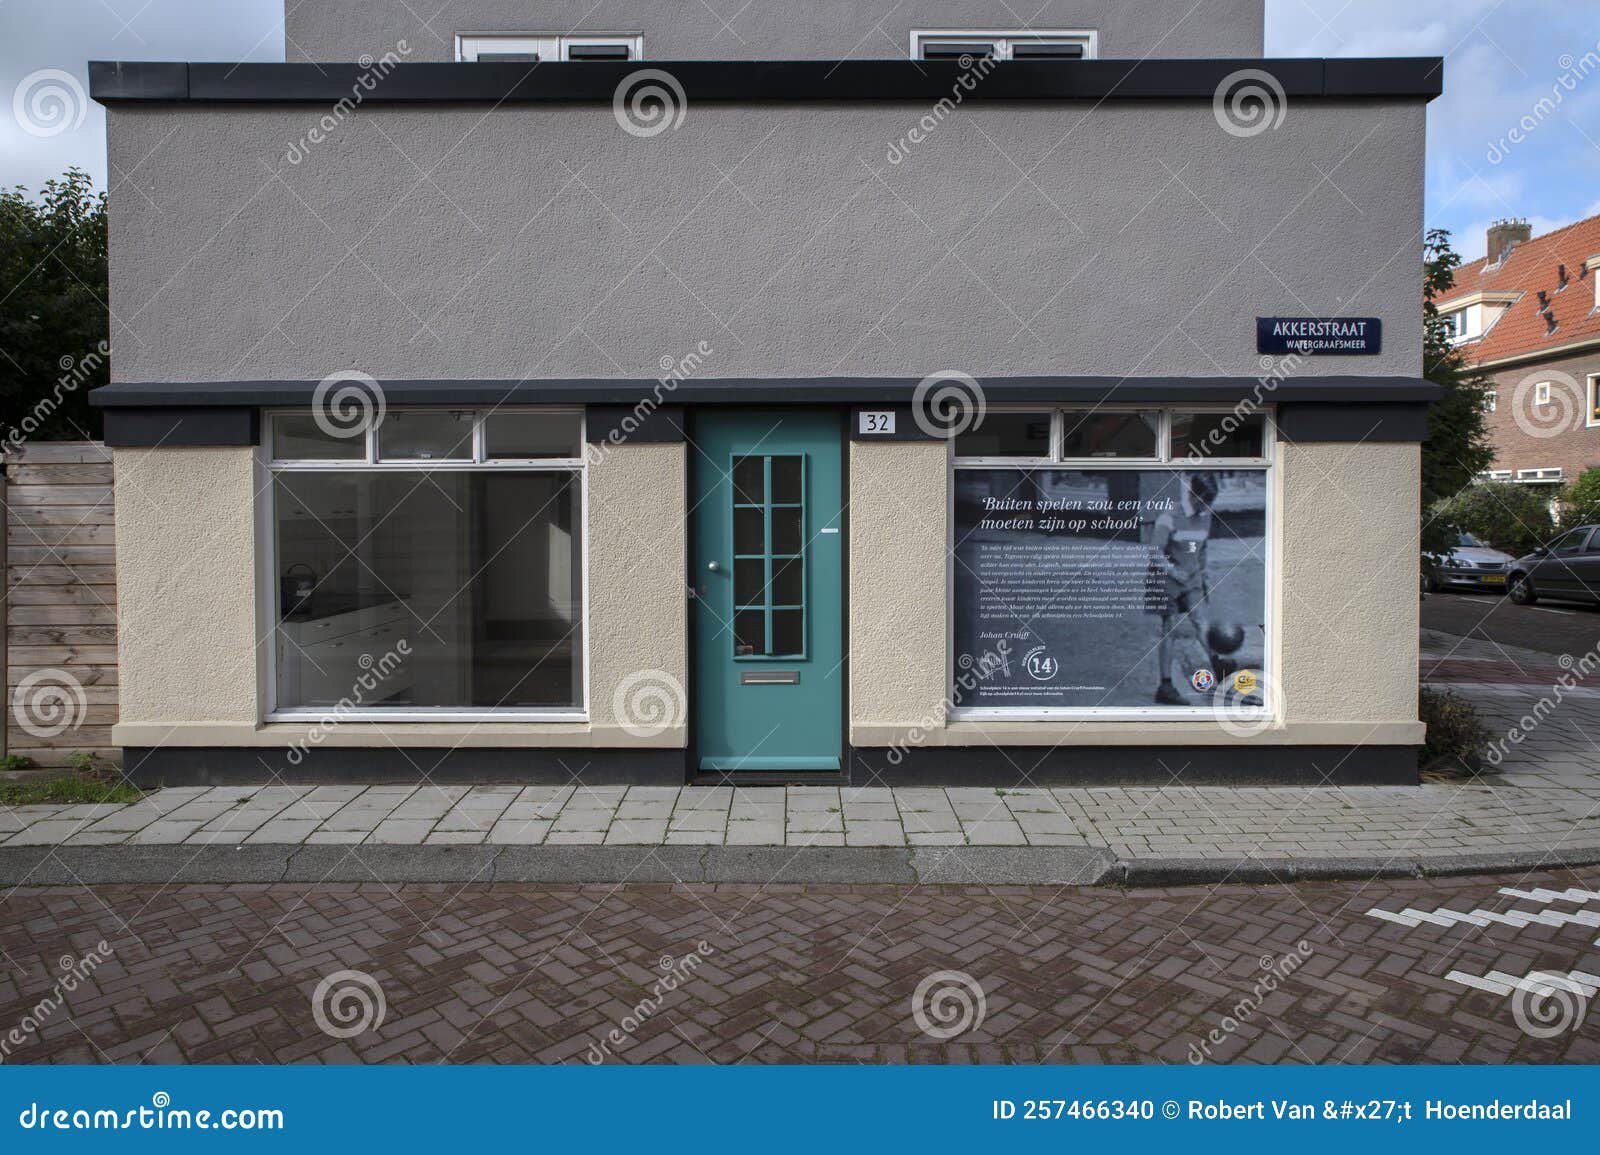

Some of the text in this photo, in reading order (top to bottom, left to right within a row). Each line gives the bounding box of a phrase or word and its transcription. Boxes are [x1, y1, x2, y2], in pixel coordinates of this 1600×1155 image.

[1273, 322, 1367, 336] AKKERSTRAAT
[1286, 340, 1366, 349] WATERGRAAFSMEER
[867, 414, 888, 431] 32
[1036, 497, 1082, 513] spelen
[1086, 499, 1113, 511] zou
[1117, 499, 1146, 511] een
[1146, 497, 1175, 511] vak
[981, 517, 1034, 529] moeten
[1039, 516, 1065, 532] zijn
[1068, 519, 1086, 532] op
[979, 632, 1003, 640] Johan
[1032, 657, 1052, 673] 14
